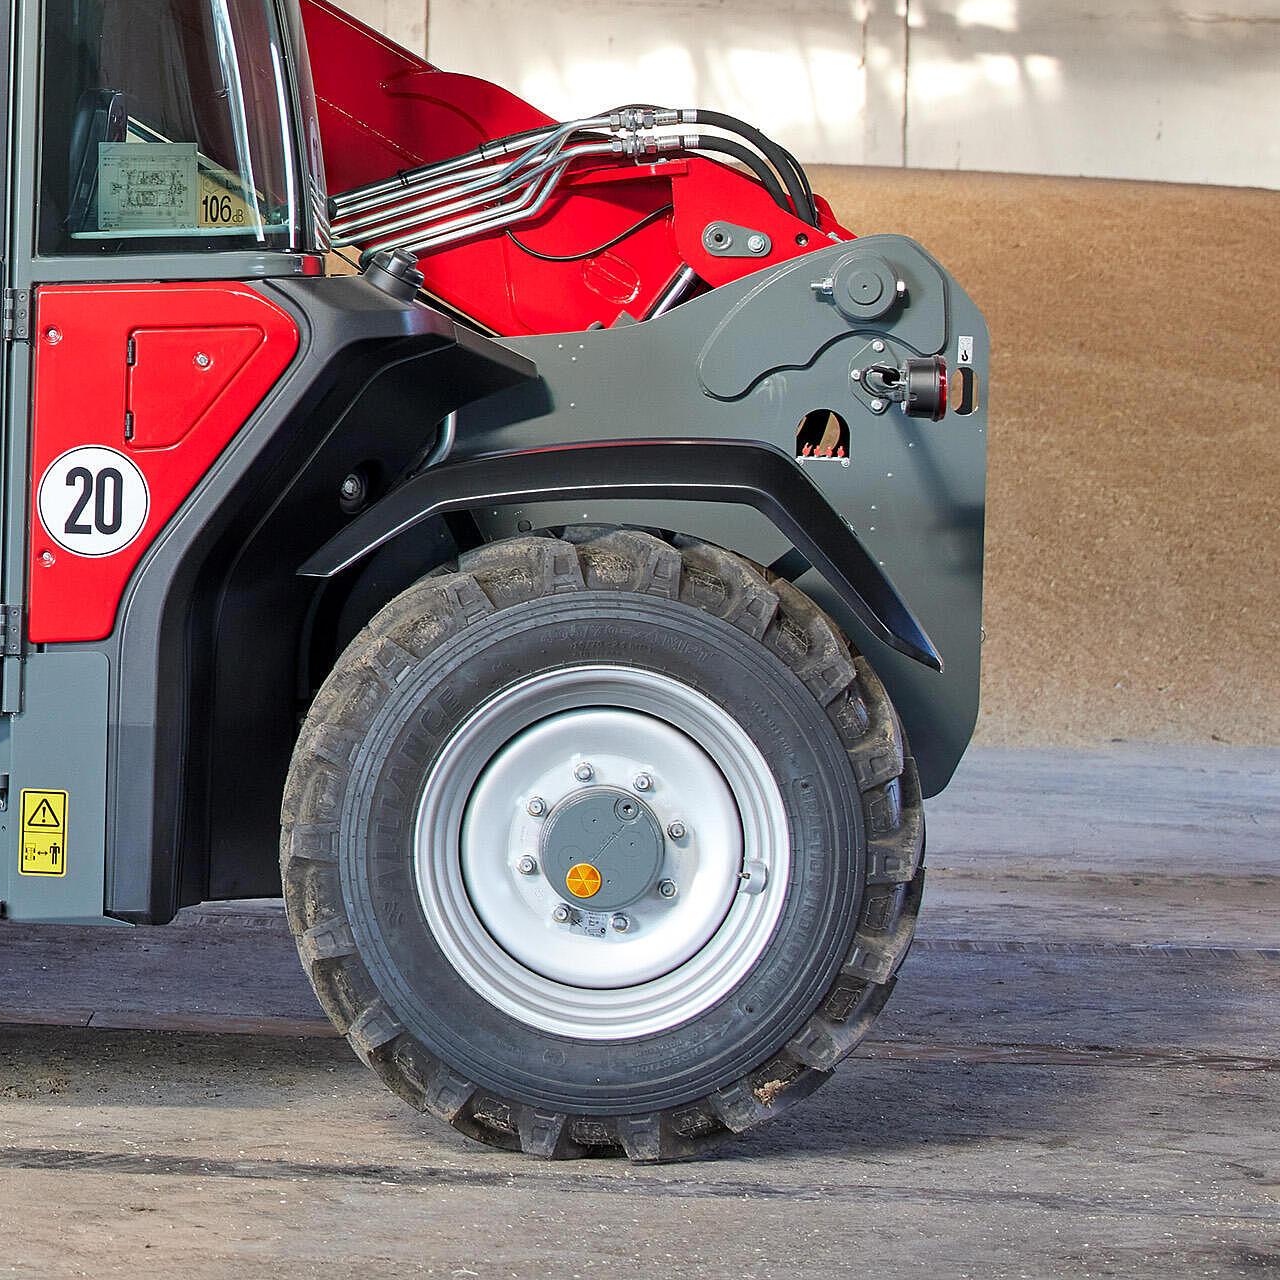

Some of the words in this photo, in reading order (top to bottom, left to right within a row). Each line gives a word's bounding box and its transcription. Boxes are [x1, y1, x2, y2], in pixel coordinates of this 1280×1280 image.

[202, 195, 232, 223] 106
[231, 209, 244, 223] dB
[64, 466, 123, 535] 20
